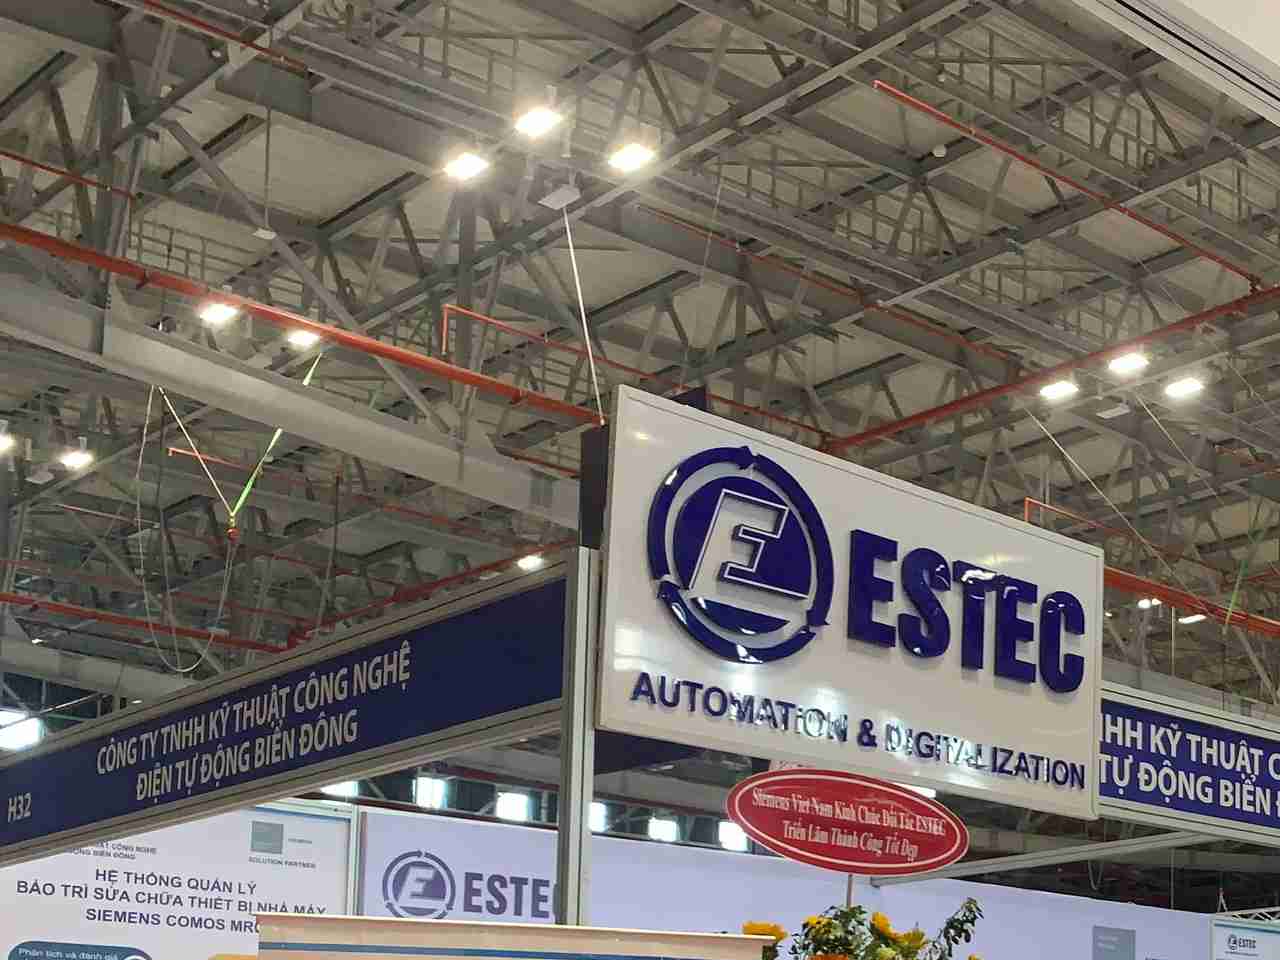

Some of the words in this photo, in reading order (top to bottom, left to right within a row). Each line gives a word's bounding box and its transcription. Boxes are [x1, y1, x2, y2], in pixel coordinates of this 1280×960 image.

[848, 529, 1086, 693] ESTEC
[96, 738, 137, 774] CÔNG
[138, 729, 160, 761] TY
[161, 719, 205, 754] TNHH
[233, 685, 290, 730] THUẬT
[294, 668, 348, 713] CÔNG
[354, 641, 411, 696] NGHỆ
[632, 671, 848, 743] AUTOMATION
[857, 718, 877, 747] &
[884, 722, 1086, 789] DIGITALIZATION
[136, 761, 173, 803] ĐIỆN
[176, 753, 198, 794] TỰ
[200, 741, 250, 787] ĐỘNG
[255, 725, 295, 769] BIỂN
[300, 710, 358, 755] ĐÔNG
[1099, 714, 1143, 751] HH
[1150, 722, 1182, 757] KỸ
[1186, 733, 1263, 776] THUẬT
[7, 792, 32, 821] H32
[752, 787, 791, 812] Siemens
[810, 797, 833, 818] Nam
[1137, 761, 1213, 803] ĐỘNG
[1219, 777, 1270, 816] BIỂN
[16, 879, 56, 896] BẢO
[93, 885, 130, 903] SỬA
[135, 886, 183, 908] CHỮA
[188, 893, 233, 912] THIẾT
[237, 899, 252, 914] BỊ
[95, 867, 118, 885] HỆ
[124, 869, 182, 888] THỐNG
[187, 877, 233, 896] QUẢN
[237, 880, 257, 896] LÝ
[464, 872, 555, 918] ESTE
[85, 908, 161, 926] SIEMENS
[166, 914, 225, 931] COMOS
